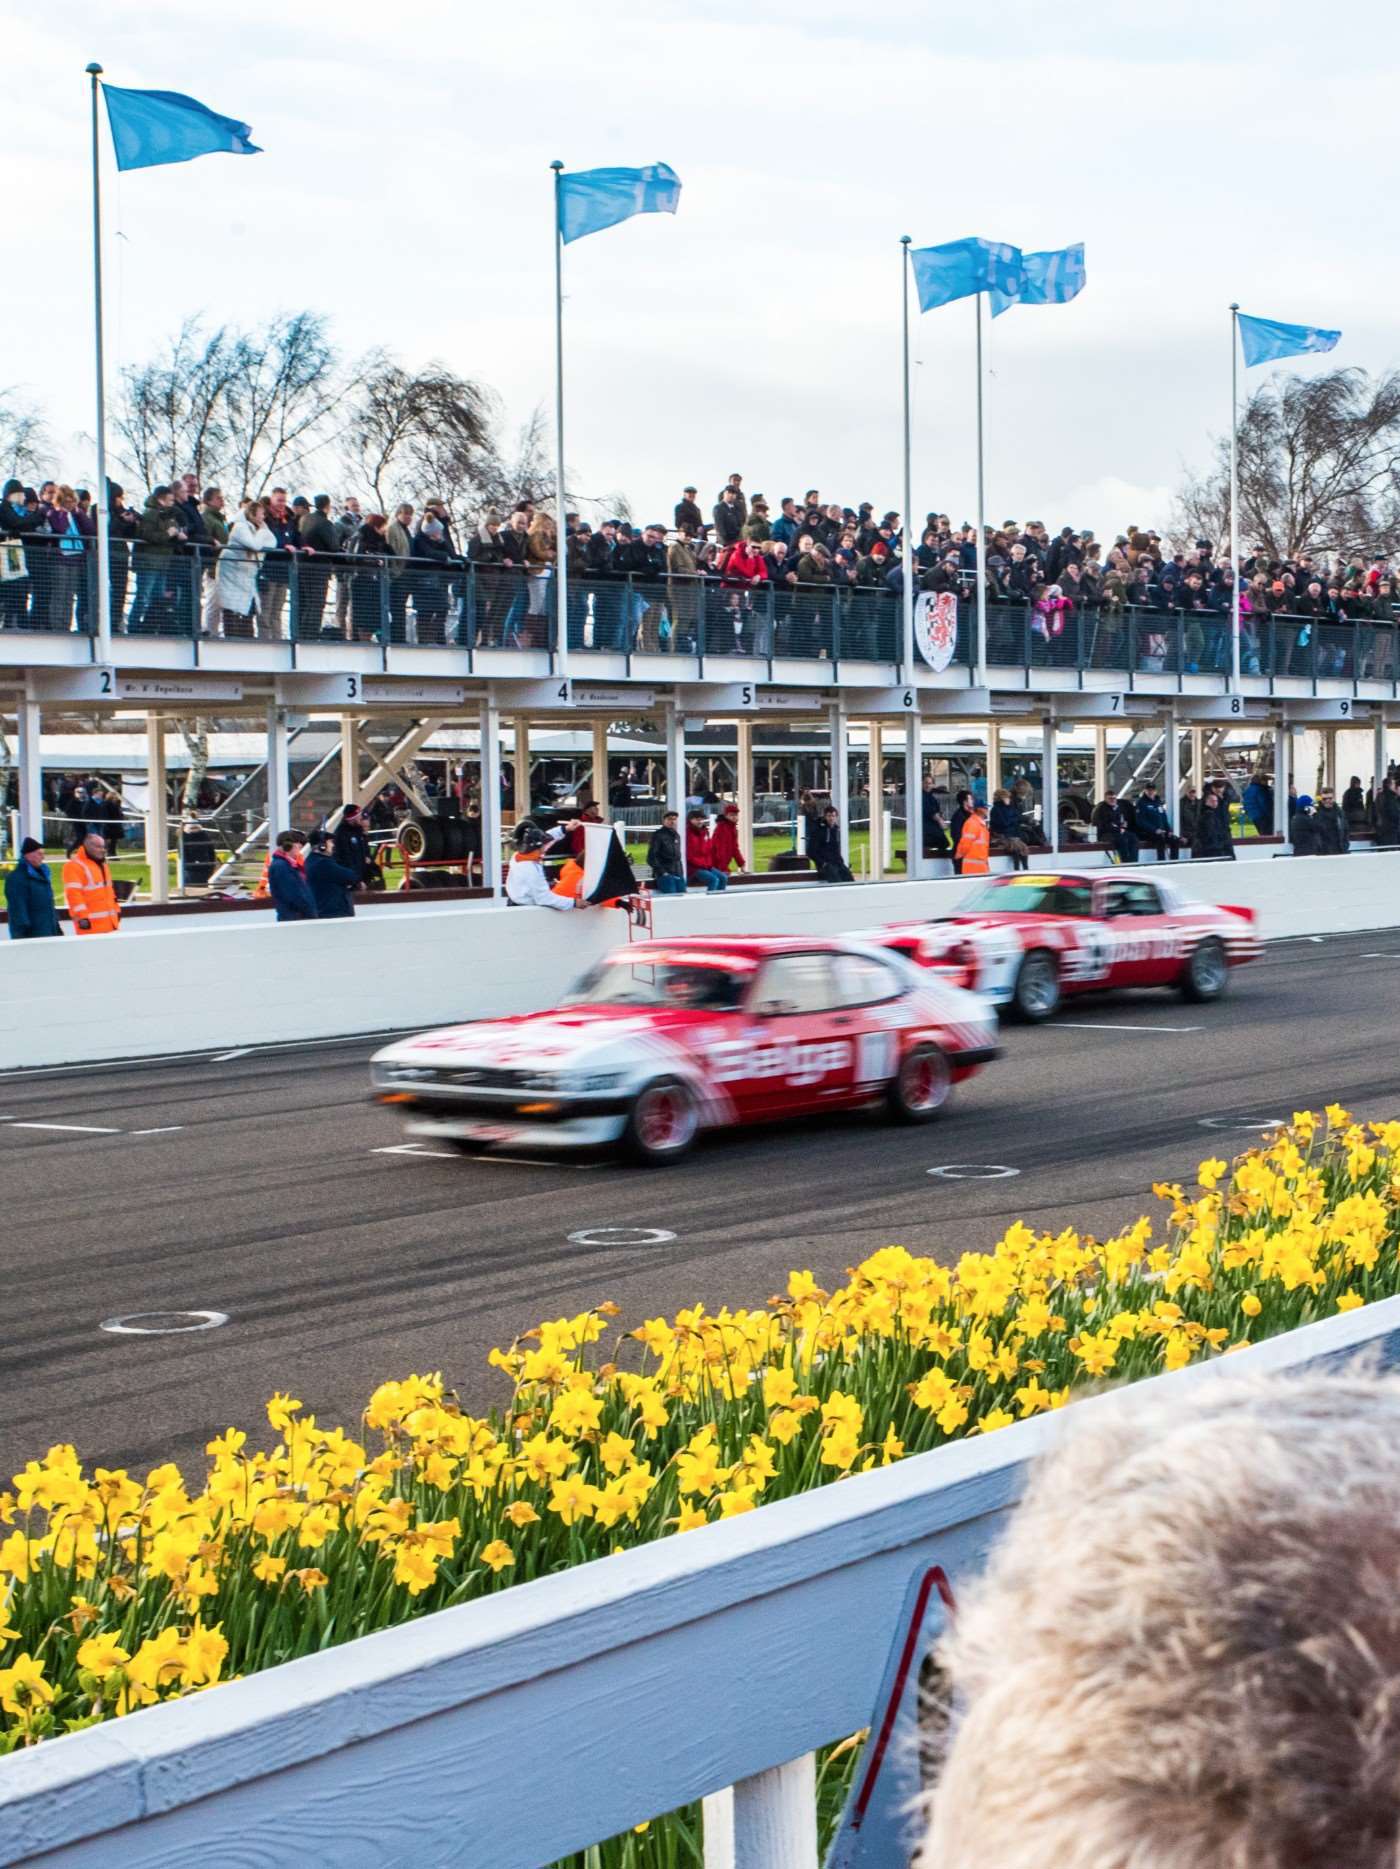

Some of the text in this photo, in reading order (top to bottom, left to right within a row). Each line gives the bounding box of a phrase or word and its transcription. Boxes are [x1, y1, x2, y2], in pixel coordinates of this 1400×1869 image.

[100, 671, 112, 694] 2
[346, 677, 357, 698] 3
[557, 682, 569, 702] 4
[741, 686, 752, 705] 5
[903, 690, 913, 707] 6
[1110, 695, 1120, 711] 7
[1230, 698, 1240, 713] 8
[1339, 701, 1349, 716] 9
